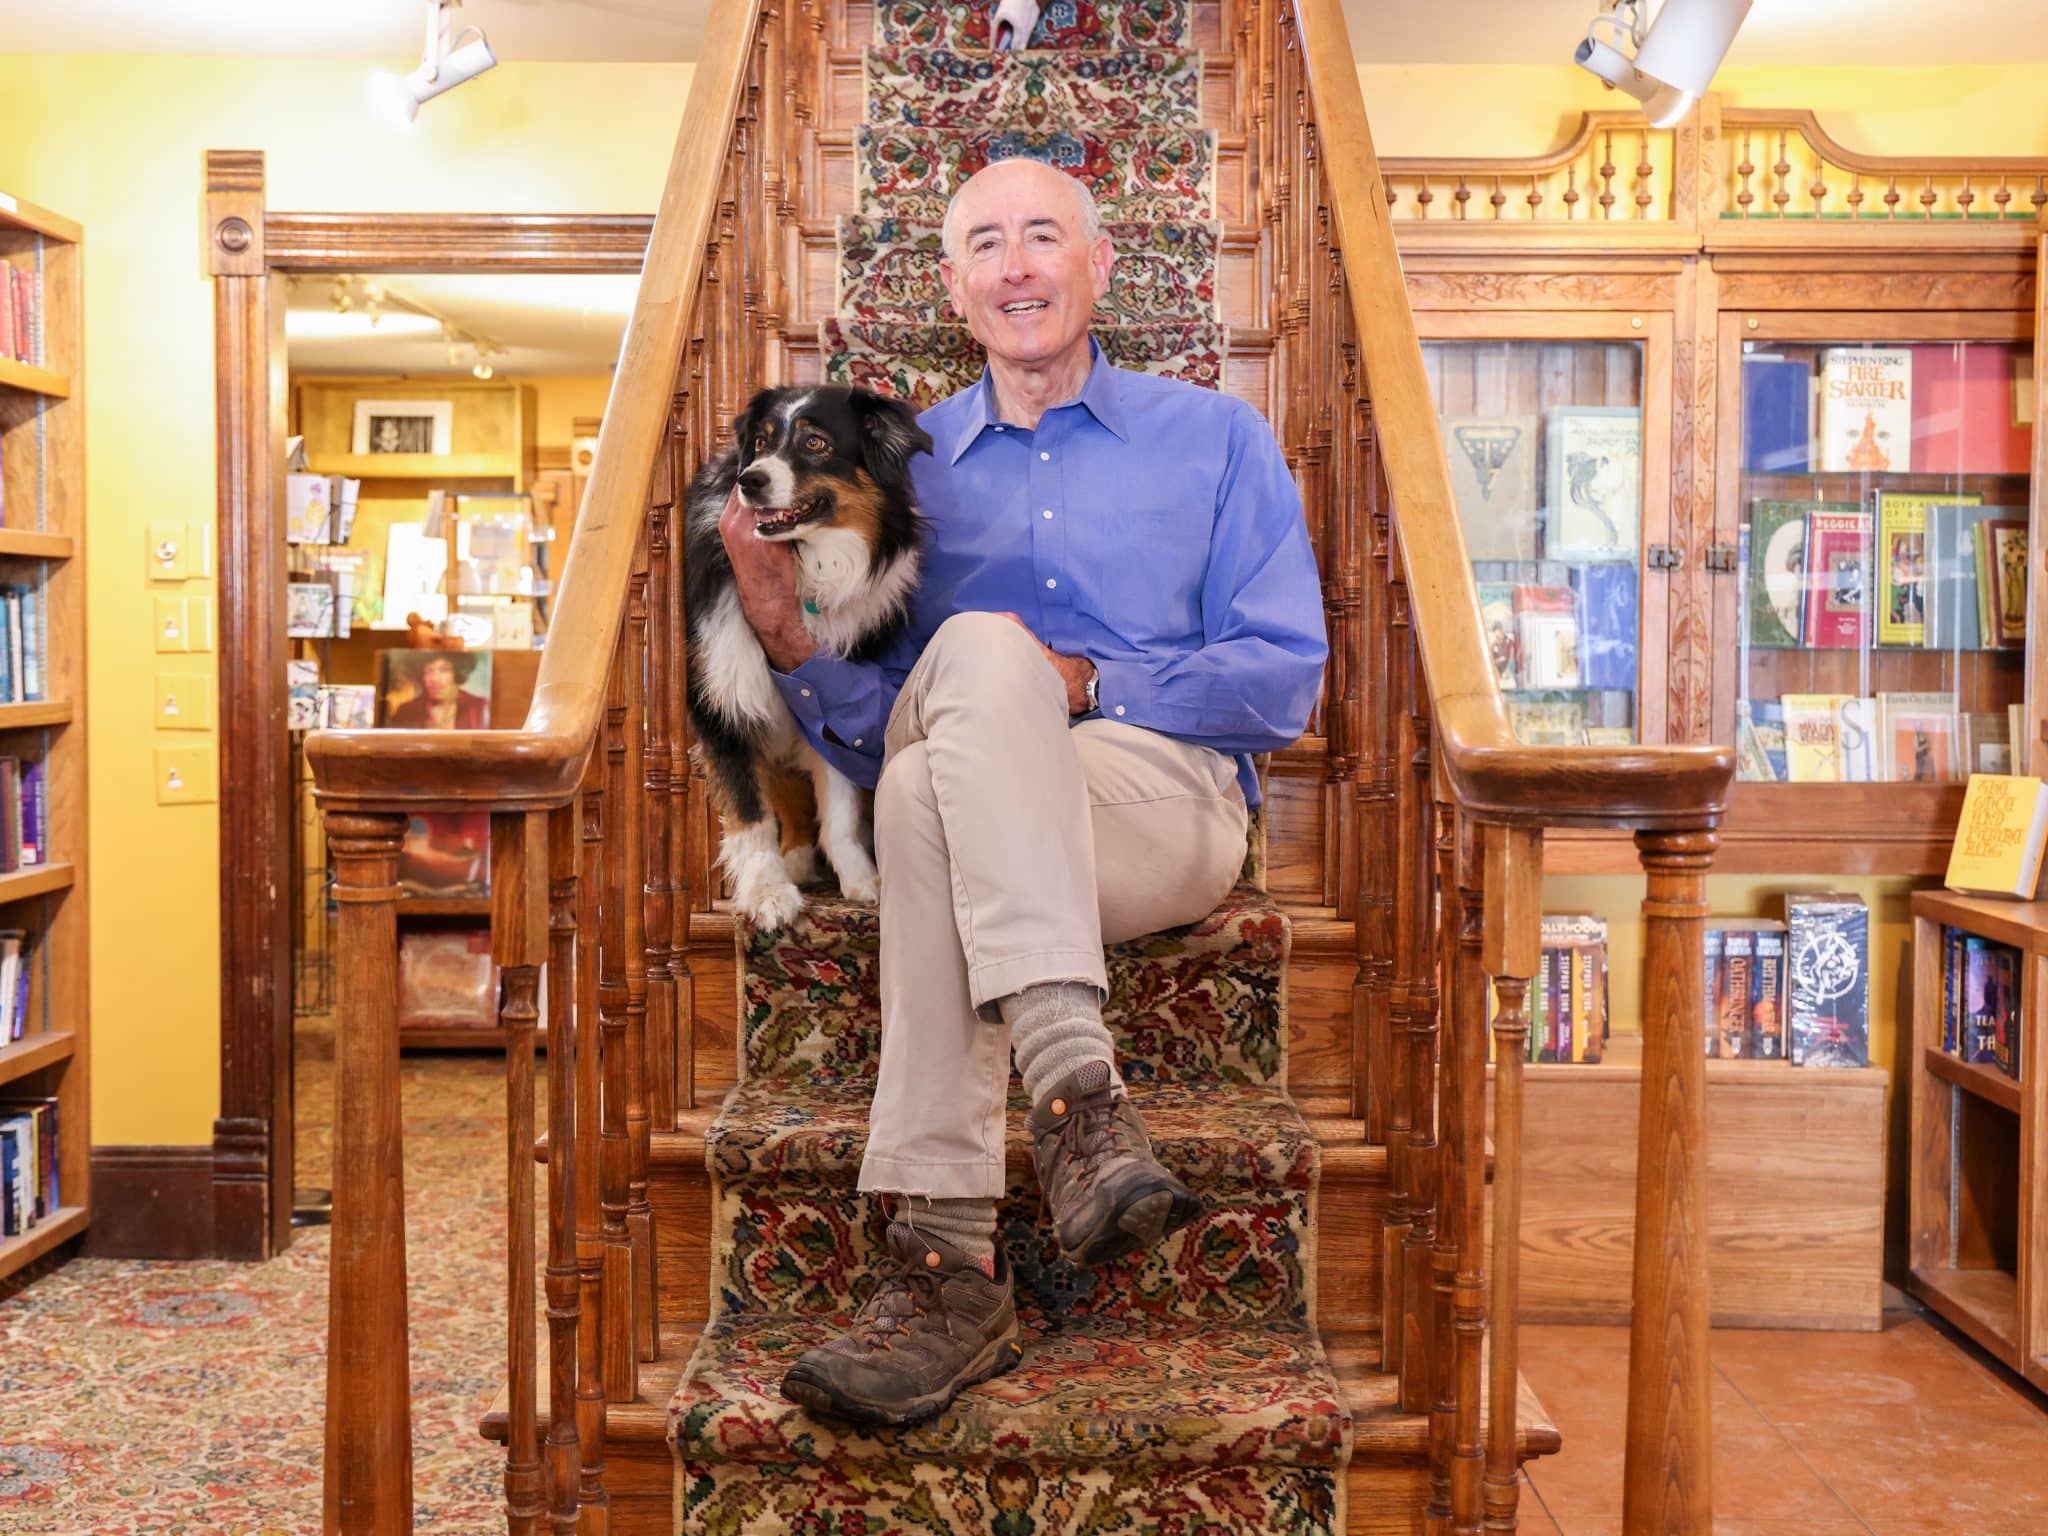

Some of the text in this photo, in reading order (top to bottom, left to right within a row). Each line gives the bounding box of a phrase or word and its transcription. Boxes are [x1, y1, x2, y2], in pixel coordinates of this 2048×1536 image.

[1831, 355, 1904, 367] STEPHEN KING
[1848, 366, 1886, 381] FIRE
[1829, 380, 1907, 401] STARTER
[1540, 954, 1549, 989] STEPHEN
[1561, 954, 1570, 990] STEPHEN
[1583, 954, 1592, 989] STEPHEN
[1729, 957, 1747, 1033] OATHBRINGER
